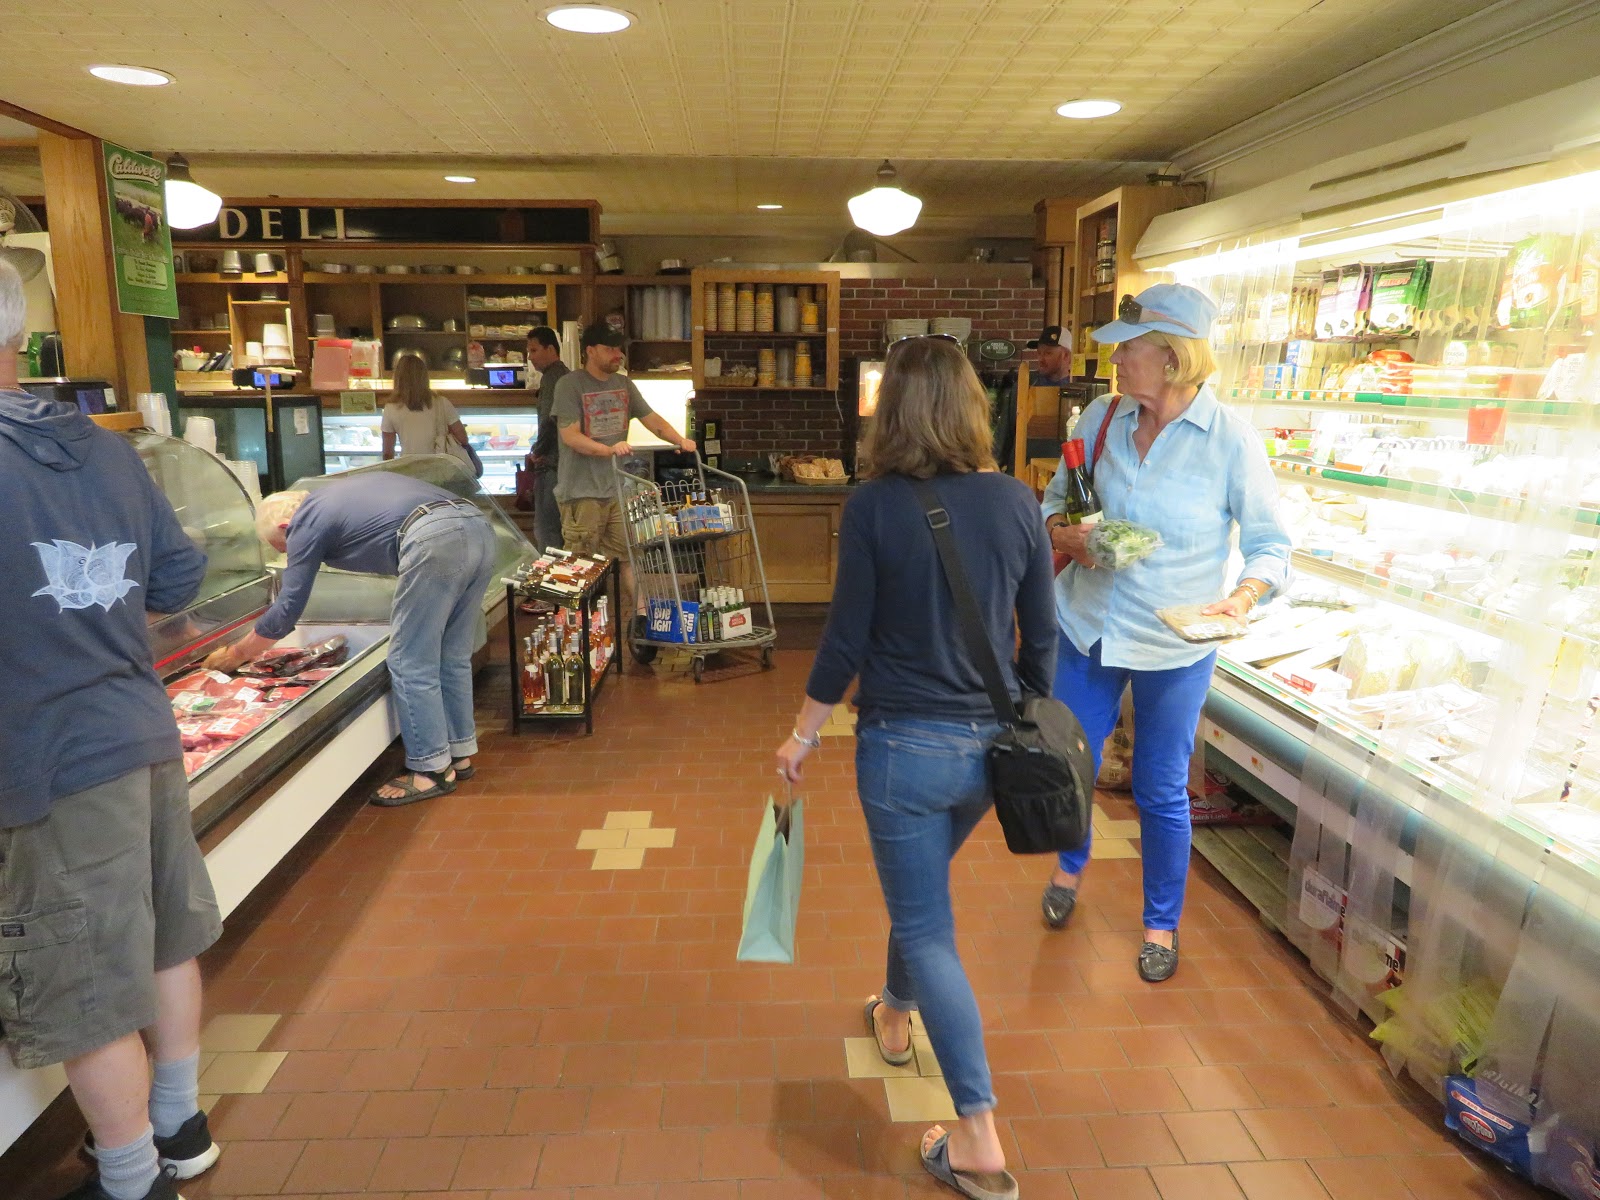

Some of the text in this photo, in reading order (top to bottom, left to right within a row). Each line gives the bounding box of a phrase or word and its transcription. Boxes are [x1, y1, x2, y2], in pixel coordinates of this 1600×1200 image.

[108, 153, 162, 185] Caldwell
[218, 207, 347, 240] DELI
[650, 620, 673, 632] LIGHT
[1304, 879, 1346, 918] duraflame
